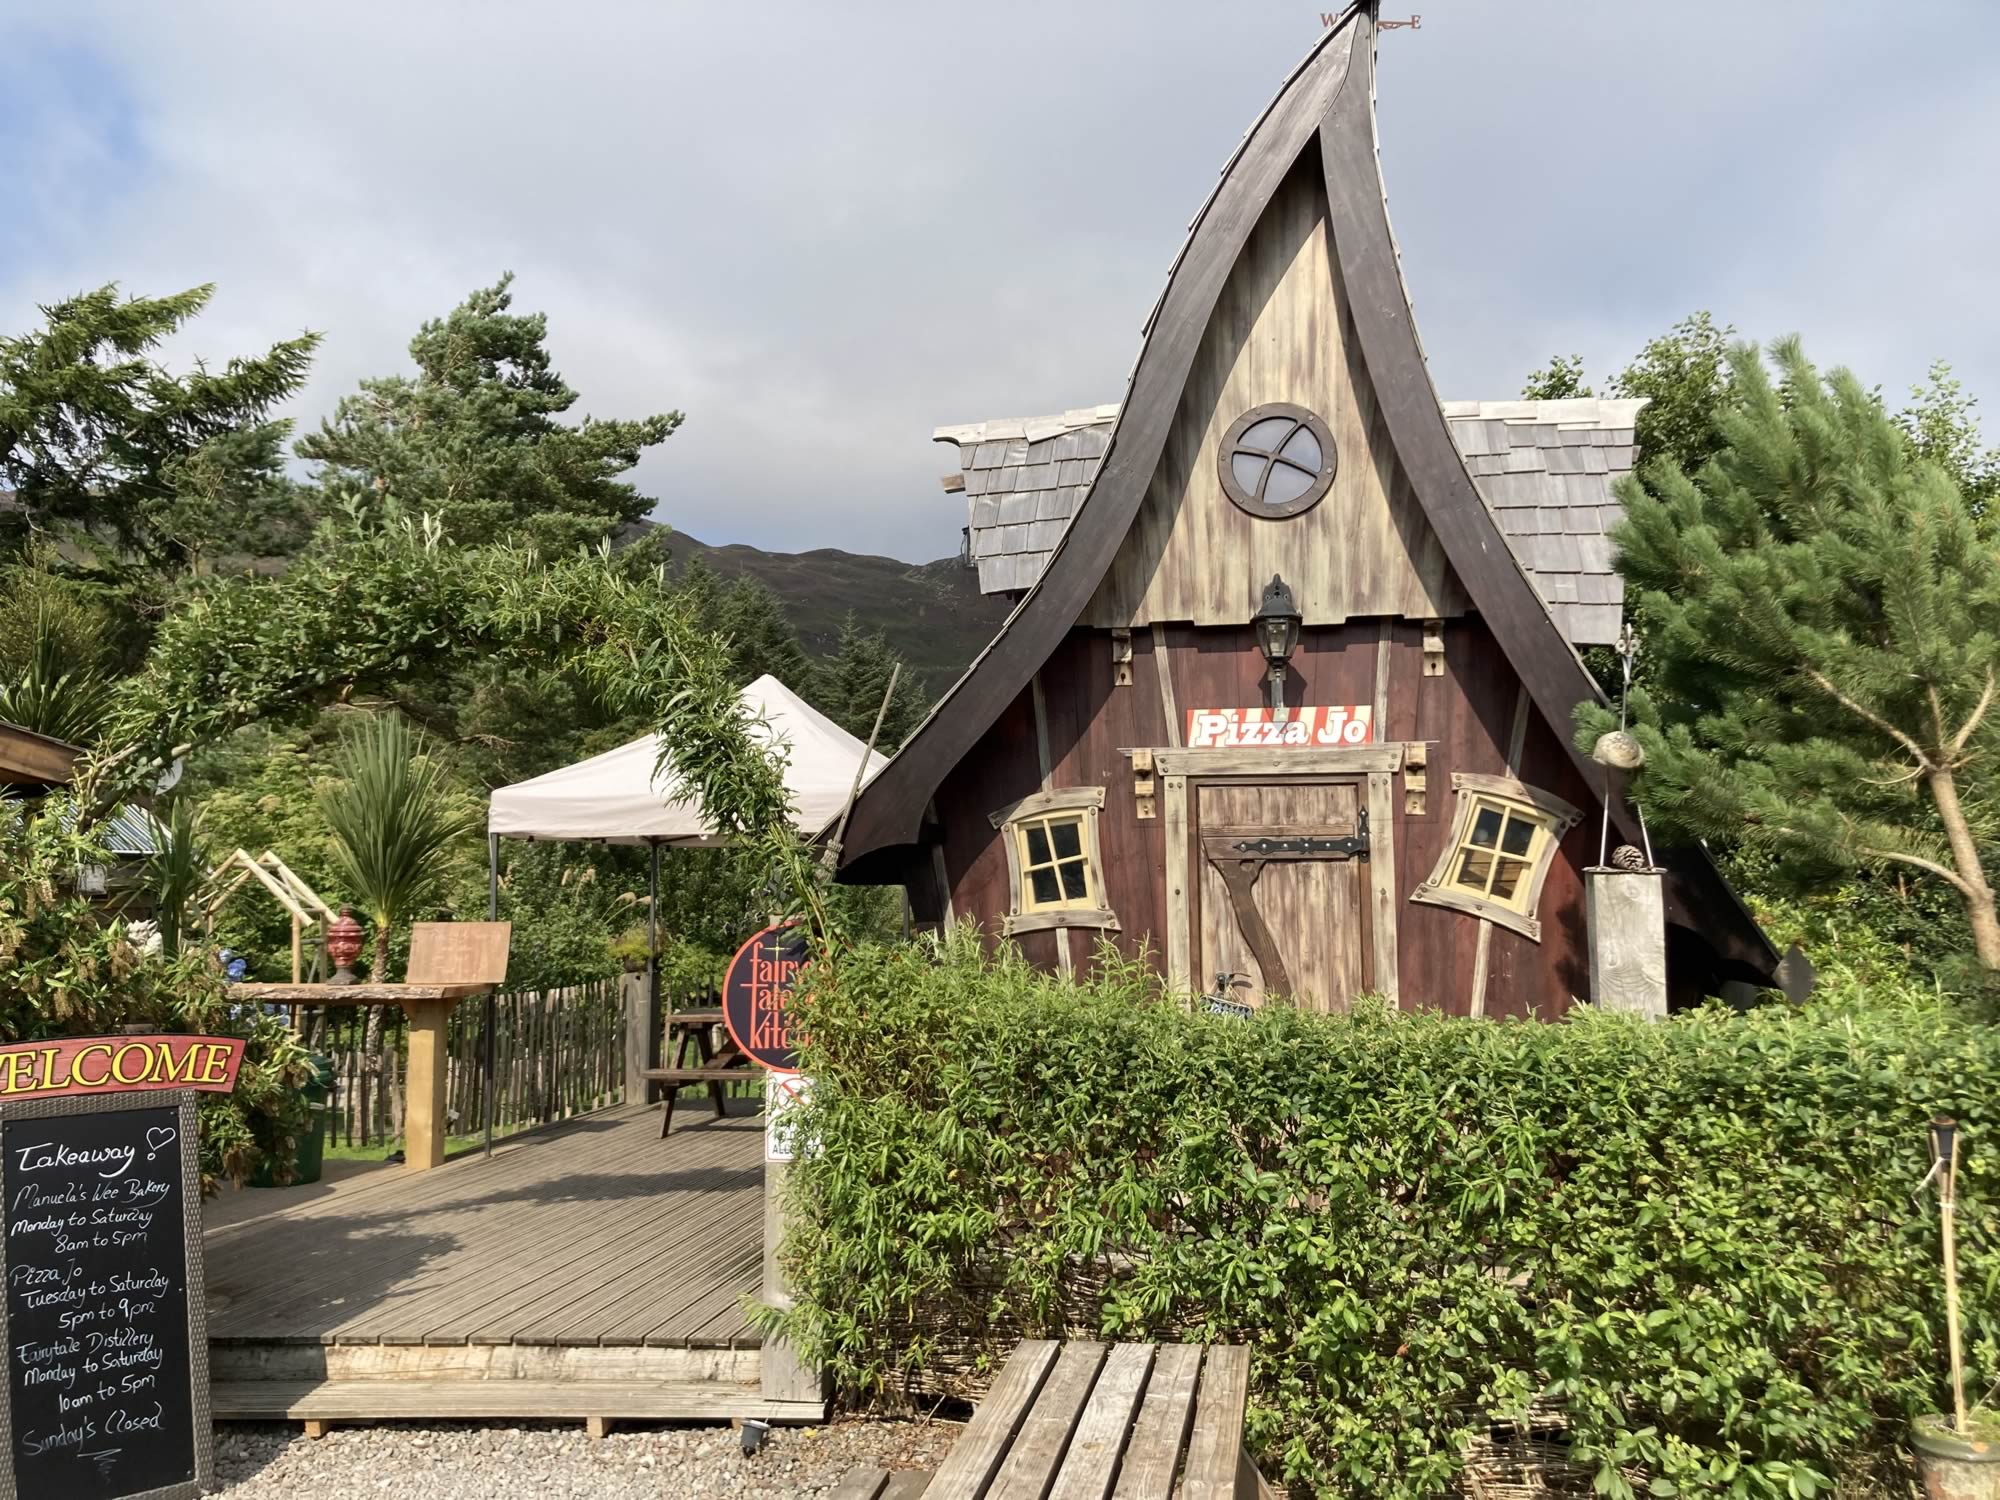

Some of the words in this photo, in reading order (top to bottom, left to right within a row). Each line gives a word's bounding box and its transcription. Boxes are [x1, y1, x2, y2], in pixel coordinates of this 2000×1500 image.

[1321, 13, 1341, 28] W
[1410, 15, 1421, 29] E
[1195, 714, 1310, 746] Pizza
[1317, 711, 1367, 744] Jo
[0, 1043, 233, 1095] ELCOME
[16, 1142, 135, 1178] Takeaway
[12, 1183, 86, 1212] Manuela's
[92, 1181, 119, 1202] Wee
[121, 1179, 170, 1209] Bakery
[11, 1215, 64, 1236] Monday
[68, 1211, 86, 1226] to
[90, 1207, 153, 1229] Saturday
[55, 1234, 89, 1253] 8am
[93, 1231, 108, 1246] to
[112, 1230, 147, 1246] 5pm
[10, 1264, 61, 1287] Pizza
[62, 1257, 83, 1286] Jo
[20, 1287, 86, 1309] Tuesday
[89, 1280, 106, 1296] to
[109, 1268, 169, 1298] Saturday
[58, 1312, 94, 1331] 5pm
[99, 1302, 115, 1320] to
[118, 1298, 156, 1322] 9pm
[16, 1336, 80, 1365] Fairytale
[85, 1327, 154, 1356] Distillery
[24, 1364, 76, 1390] Monday
[82, 1358, 98, 1374] to
[102, 1348, 163, 1370] Saturday
[58, 1393, 93, 1414] 10am
[97, 1381, 116, 1400] to
[121, 1373, 156, 1394] 5pm
[22, 1415, 97, 1456] Sunday's
[104, 1401, 167, 1434] Closed
